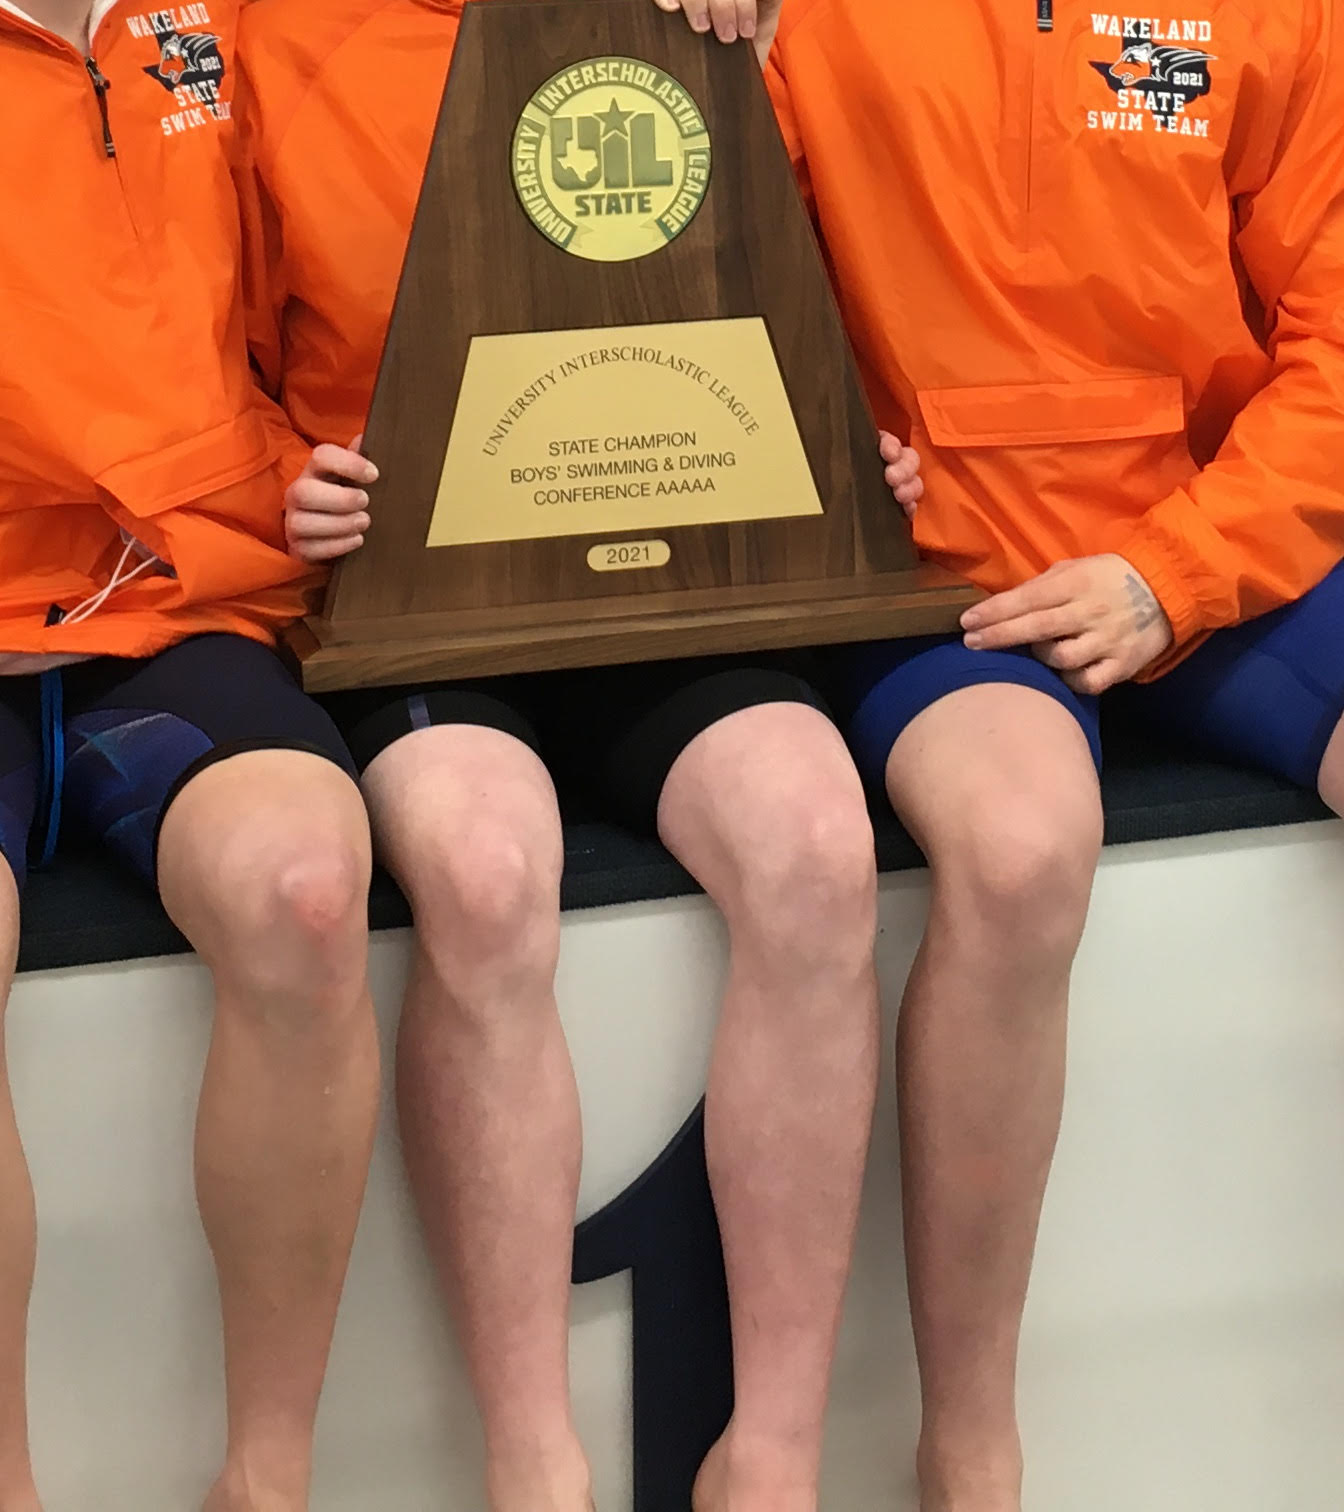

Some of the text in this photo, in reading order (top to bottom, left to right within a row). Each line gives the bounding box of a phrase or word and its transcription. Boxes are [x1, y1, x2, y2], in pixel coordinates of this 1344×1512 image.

[126, 2, 211, 39] WAKELAND
[1091, 13, 1212, 42] WAKELAND
[199, 56, 221, 72] 2021
[173, 79, 220, 107] STATE
[1173, 72, 1204, 87] 2021
[1117, 88, 1186, 112] STATE
[160, 108, 206, 136] SWIM
[1087, 110, 1209, 137] SWIM TEAM
[516, 62, 707, 243] UNIVERSITY INTERSCHOLASTIC LEAGUE
[549, 97, 674, 191] UIL
[574, 190, 652, 218] STATE
[482, 345, 760, 458] UNIVERSITY INTERSCHOLASTIC LEAGUE
[548, 431, 697, 457] STATE CHAMPION
[567, 457, 658, 480] SWIMMING
[663, 457, 675, 472] &
[679, 451, 736, 471] DIVING
[533, 477, 716, 506] CONFERENCE AAAAA
[606, 545, 652, 565] 2021
